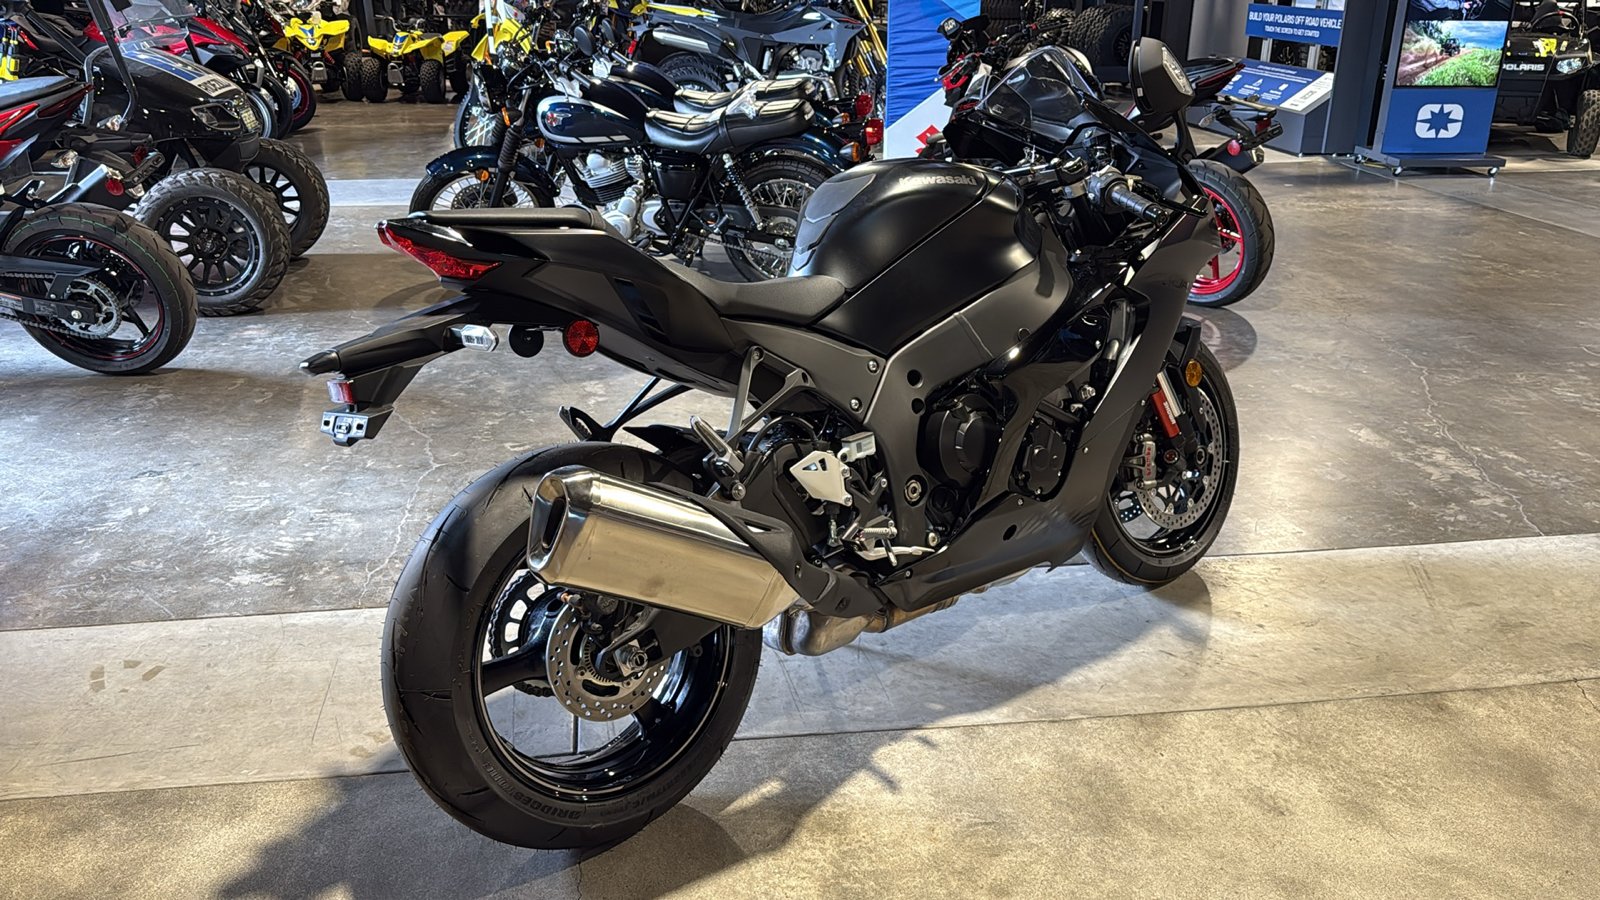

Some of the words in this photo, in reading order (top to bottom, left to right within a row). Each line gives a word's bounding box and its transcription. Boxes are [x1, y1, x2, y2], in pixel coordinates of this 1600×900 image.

[1249, 11, 1262, 21] BUILD
[1263, 12, 1275, 22] YOUR
[1275, 14, 1295, 24] POLARIS
[1295, 15, 1305, 25] OFF
[1305, 16, 1319, 27] ROAD
[1320, 18, 1342, 29] VEHICLE
[899, 175, 977, 186] Kawasaki
[482, 761, 582, 820] BRIDGESTONE
